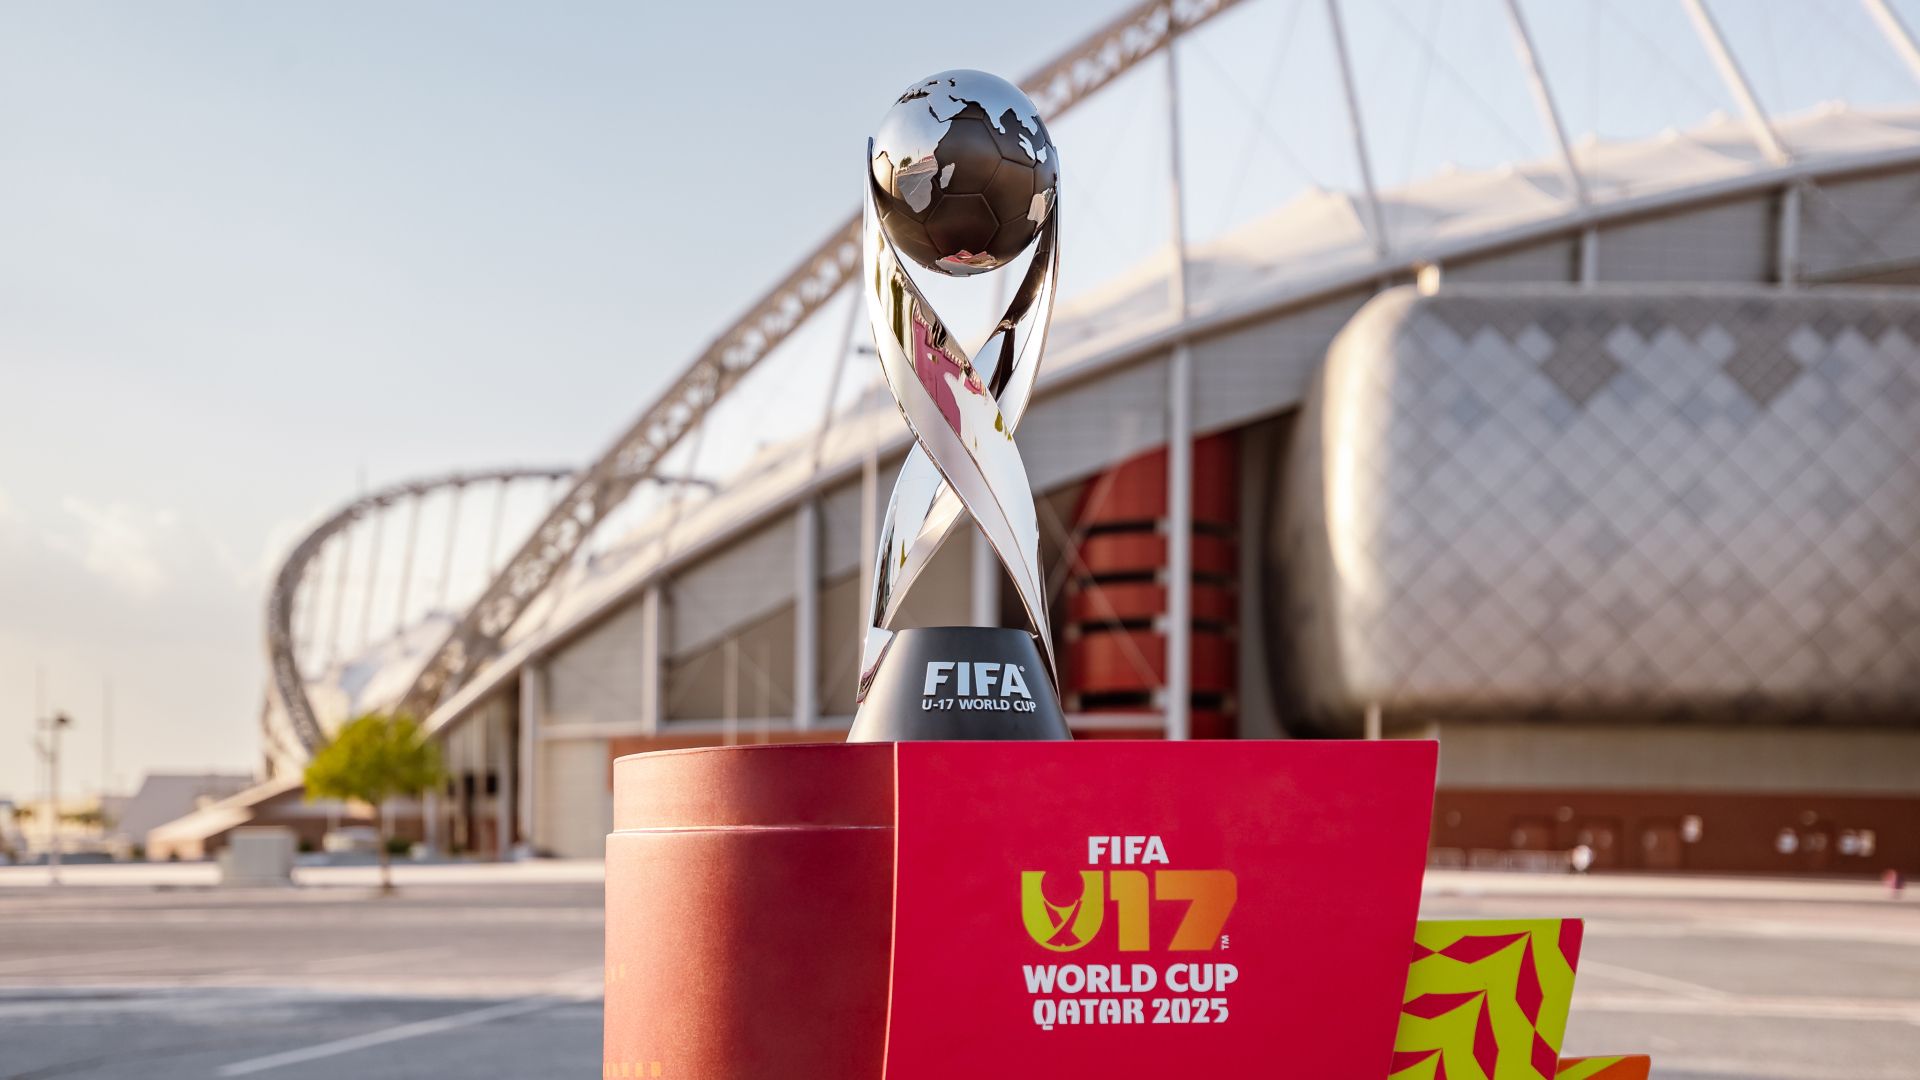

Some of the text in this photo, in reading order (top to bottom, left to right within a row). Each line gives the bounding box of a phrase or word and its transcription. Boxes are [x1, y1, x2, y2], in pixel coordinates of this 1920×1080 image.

[922, 699, 1036, 713] U-17 WORLD CUP
[1088, 836, 1169, 864] FIFA
[1021, 870, 1237, 952] U17
[1023, 964, 1238, 993] WORLD CUP
[1033, 998, 1228, 1030] QATAR 2025
